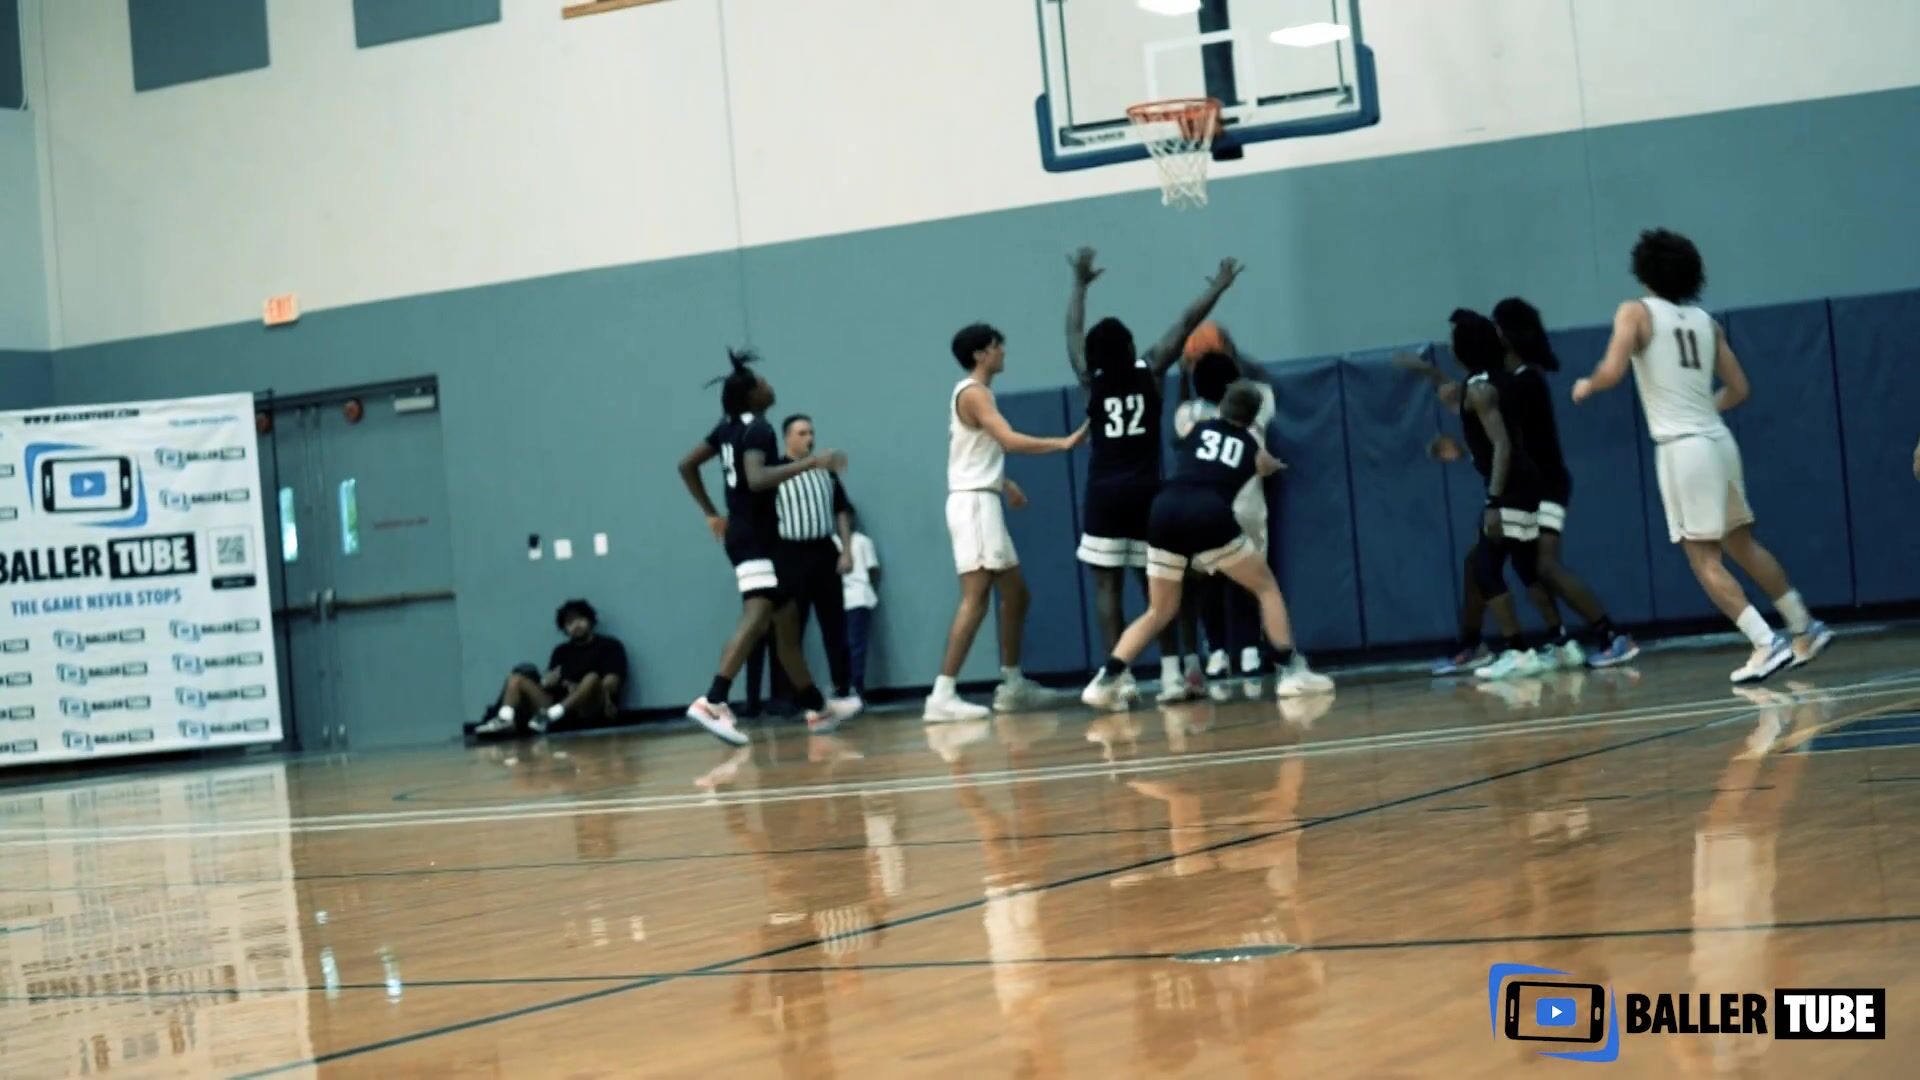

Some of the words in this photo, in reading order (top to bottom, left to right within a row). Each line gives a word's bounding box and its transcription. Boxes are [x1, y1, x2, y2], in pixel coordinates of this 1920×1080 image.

[1673, 328, 1702, 369] 11
[1104, 393, 1146, 438] 32
[1196, 429, 1245, 468] 30
[112, 536, 191, 576] TUBE
[12, 600, 38, 616] THE
[42, 596, 82, 613] GAME
[87, 592, 134, 609] NEVER
[137, 587, 182, 606] STOPS
